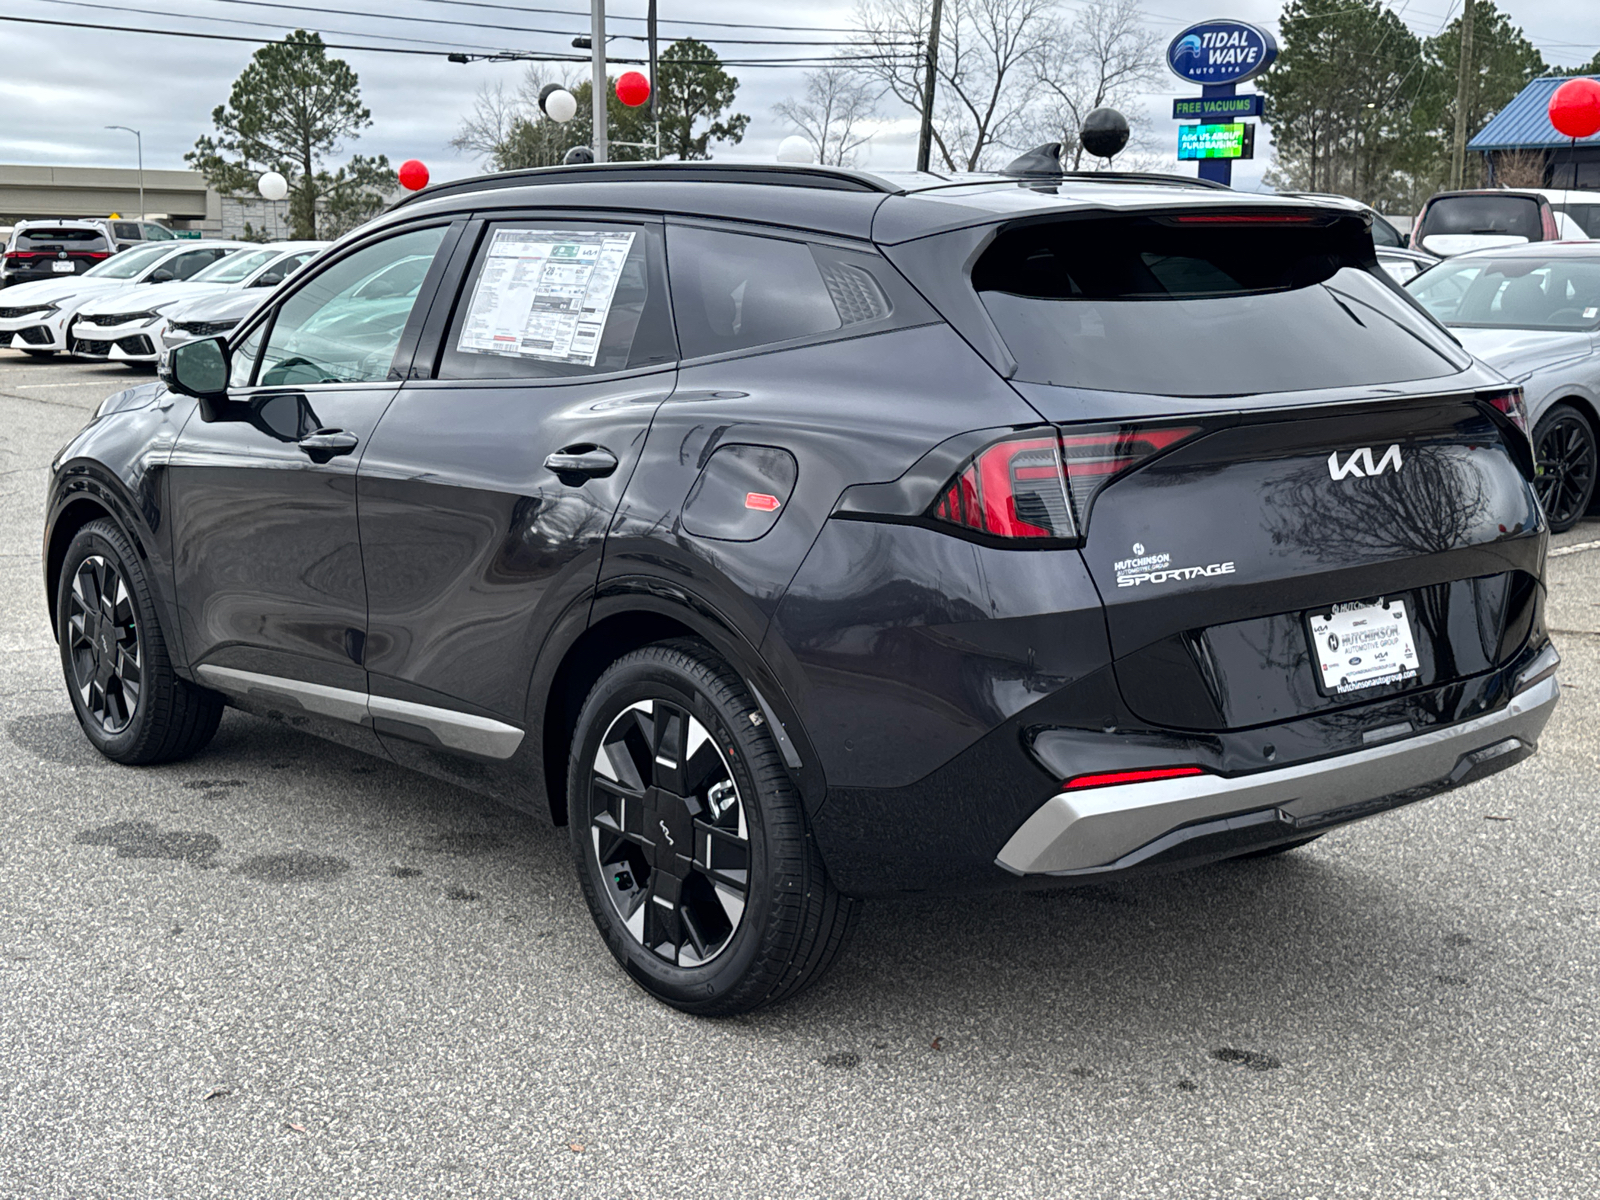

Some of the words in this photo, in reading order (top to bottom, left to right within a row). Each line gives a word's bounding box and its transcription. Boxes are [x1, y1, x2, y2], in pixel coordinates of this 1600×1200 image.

[1202, 31, 1248, 48] TIDAL
[1208, 47, 1258, 65] WAVE
[1189, 67, 1215, 75] AUTO
[1221, 66, 1240, 74] SPA
[1176, 102, 1201, 113] FREE
[1204, 99, 1250, 111] VACUUMS
[1181, 133, 1198, 141] ASK
[1199, 132, 1211, 141] US
[1211, 130, 1242, 140] ABOUT
[1327, 443, 1403, 481] KIA
[1114, 553, 1171, 572] HUTCHINSON
[1117, 562, 1236, 587] SPORTAGE
[1341, 624, 1400, 647] HUTCHINSON
[1345, 641, 1379, 654] AUTOMOTIVE
[1380, 637, 1400, 648] GROUP
